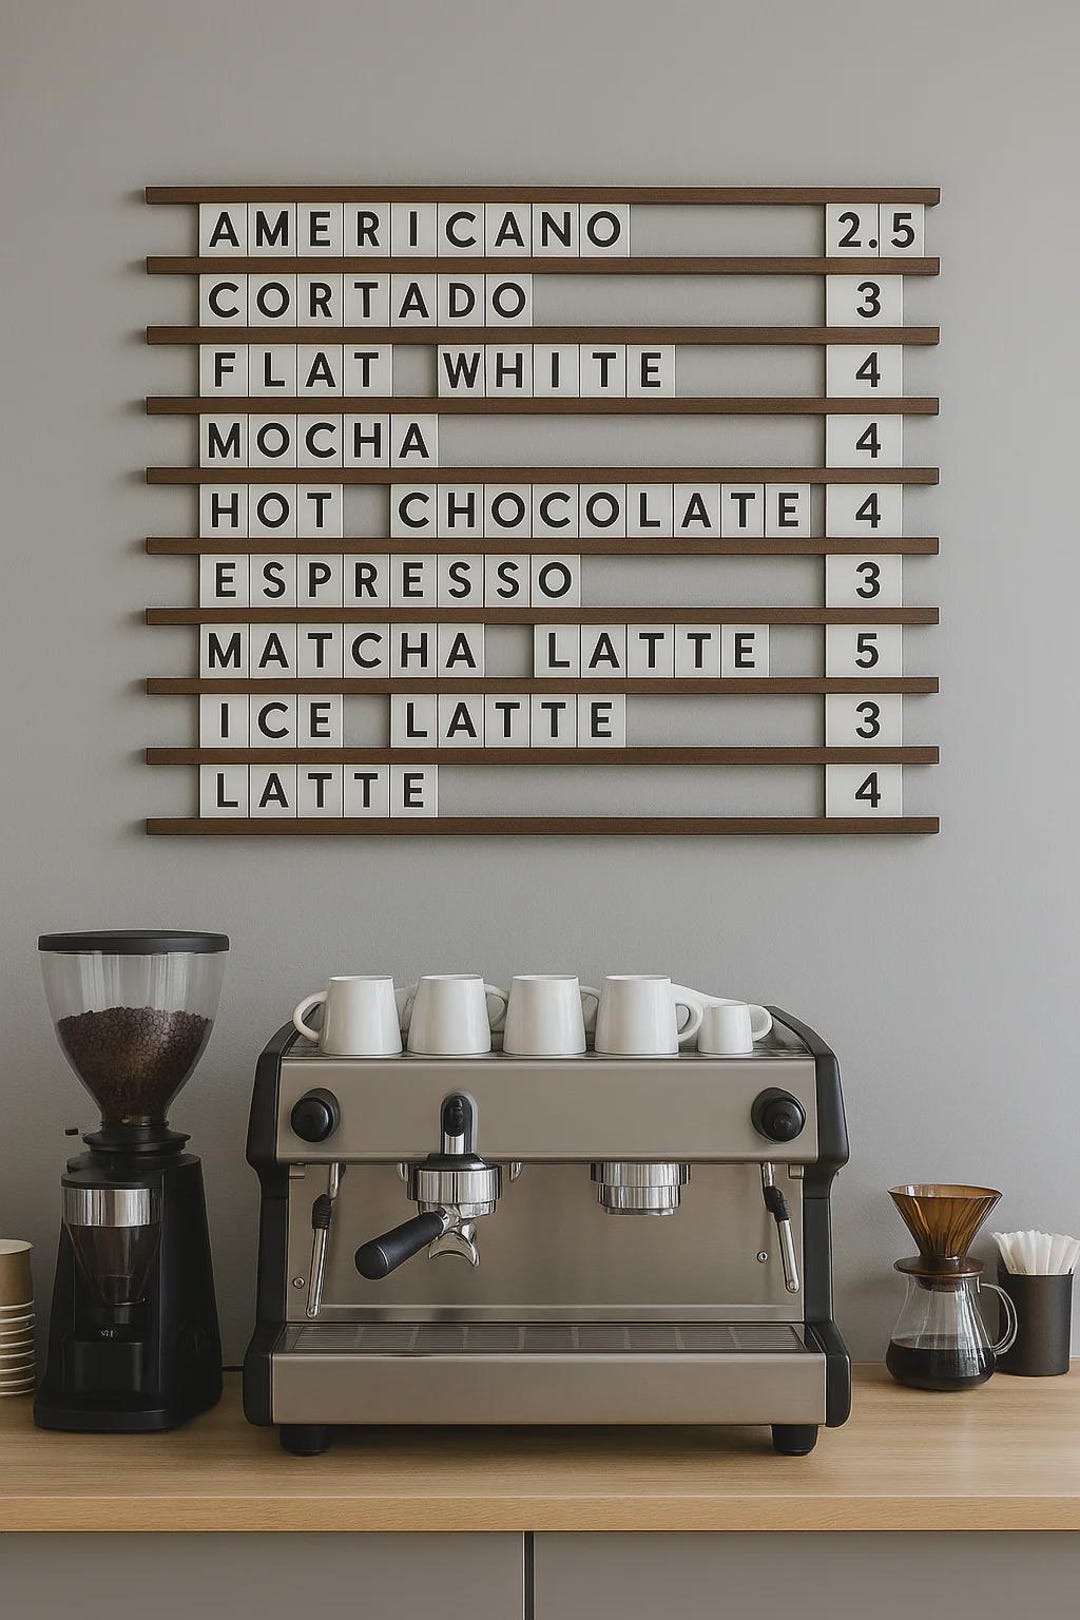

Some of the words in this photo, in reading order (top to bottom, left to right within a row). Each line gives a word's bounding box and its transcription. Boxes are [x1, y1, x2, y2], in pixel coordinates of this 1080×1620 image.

[208, 211, 621, 248] AMERICANO
[838, 211, 915, 249] 2.5
[208, 282, 526, 318] CORTADO
[856, 282, 881, 318] 3
[214, 352, 379, 388] FLAT
[440, 352, 662, 388] WHITE
[855, 352, 881, 388] 4
[208, 422, 430, 458] MOCHA
[855, 422, 881, 458] 4
[211, 492, 332, 528] HOT
[398, 492, 799, 528] CHOCOLATE
[855, 492, 881, 528] 4
[215, 562, 572, 598] ESPRESSO
[856, 562, 880, 598] 3
[208, 632, 477, 668] MATCHA
[548, 632, 755, 668] LATTE
[855, 633, 879, 668] 5
[221, 702, 331, 738] ICE
[406, 702, 613, 738] LATTE
[855, 702, 880, 738] 3
[217, 772, 424, 808] LATTE
[855, 772, 881, 808] 4
